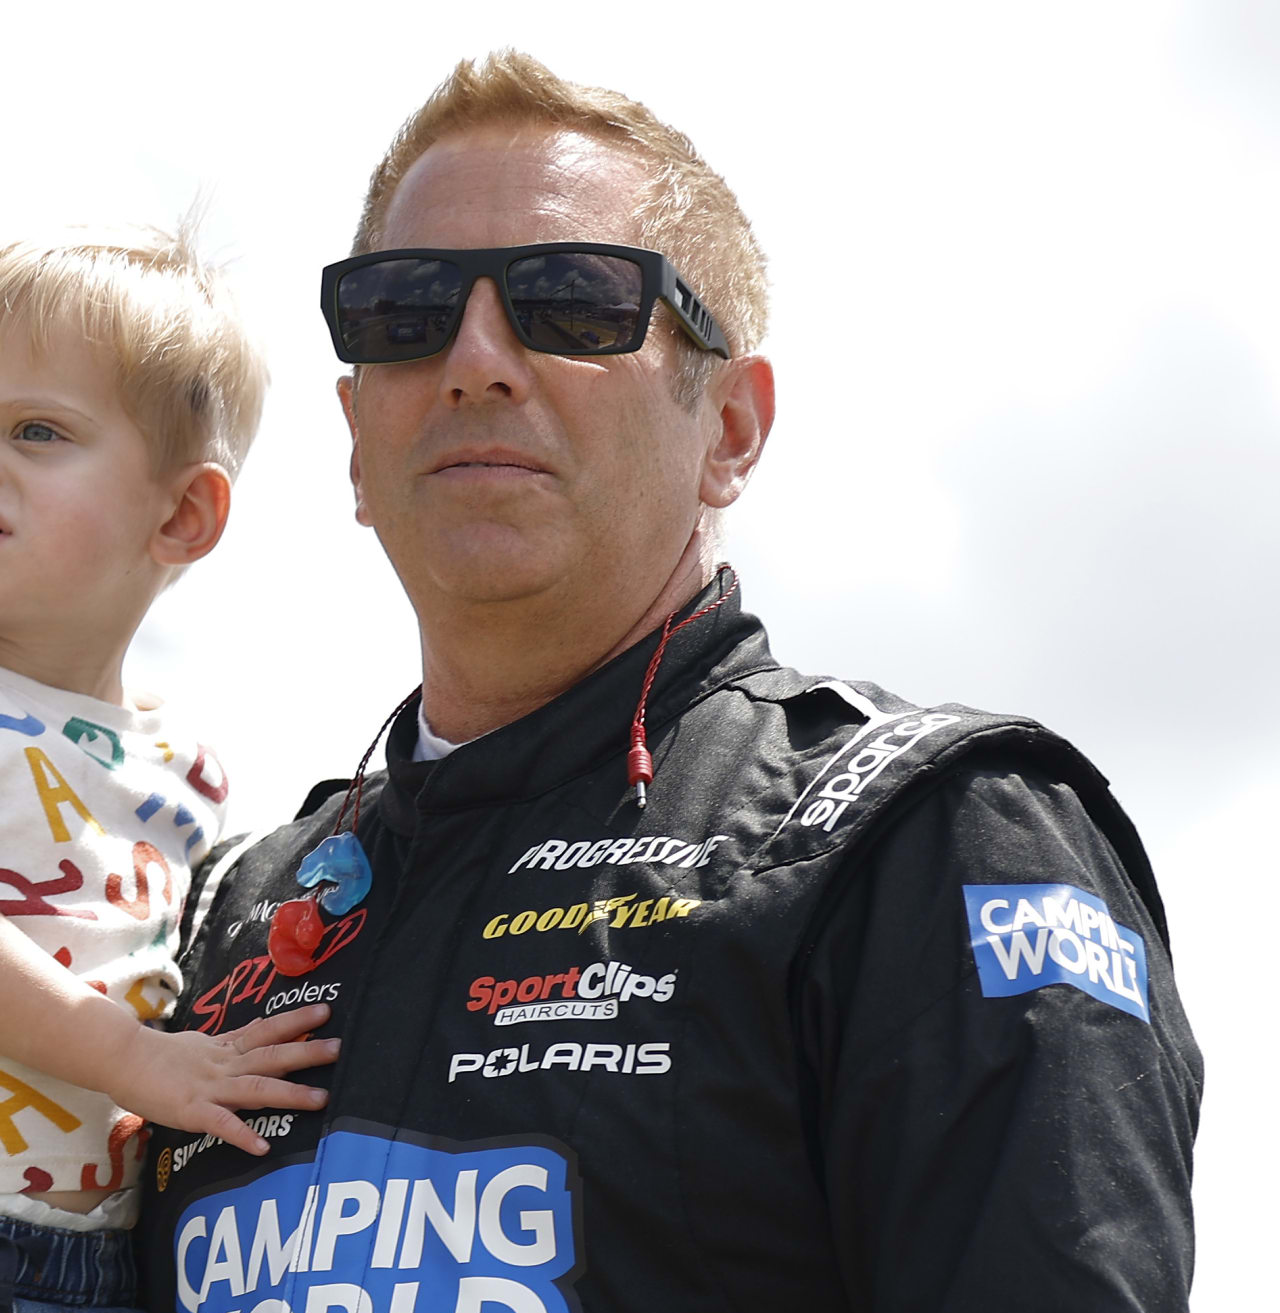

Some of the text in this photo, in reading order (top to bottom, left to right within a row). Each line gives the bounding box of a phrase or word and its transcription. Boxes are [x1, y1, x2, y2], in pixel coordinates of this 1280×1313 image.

[801, 713, 961, 832] sparco
[24, 746, 106, 843] A
[507, 835, 732, 875] PROGRESSIVE
[482, 892, 702, 940] GOODYEAR
[265, 981, 341, 1015] coolers
[499, 1002, 615, 1024] HAIRCUTS
[448, 1042, 672, 1083] POLARIS
